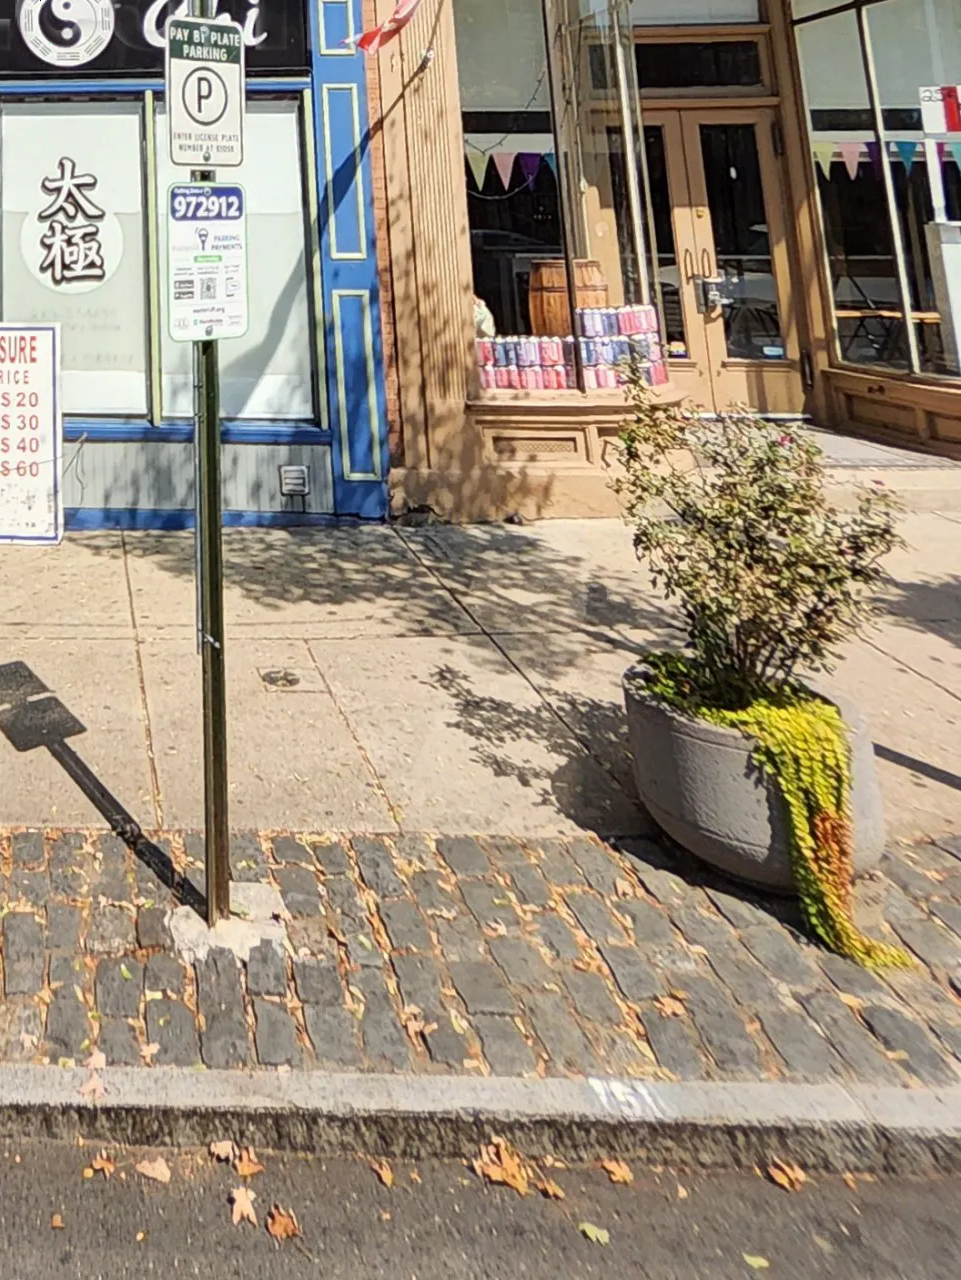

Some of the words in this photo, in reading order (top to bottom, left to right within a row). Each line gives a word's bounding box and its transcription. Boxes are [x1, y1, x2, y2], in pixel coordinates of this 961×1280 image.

[170, 26, 189, 41] PAY
[211, 31, 240, 46] PLATE
[183, 44, 228, 60] PARKING
[174, 196, 240, 218] 972912
[37, 157, 105, 284] 太極
